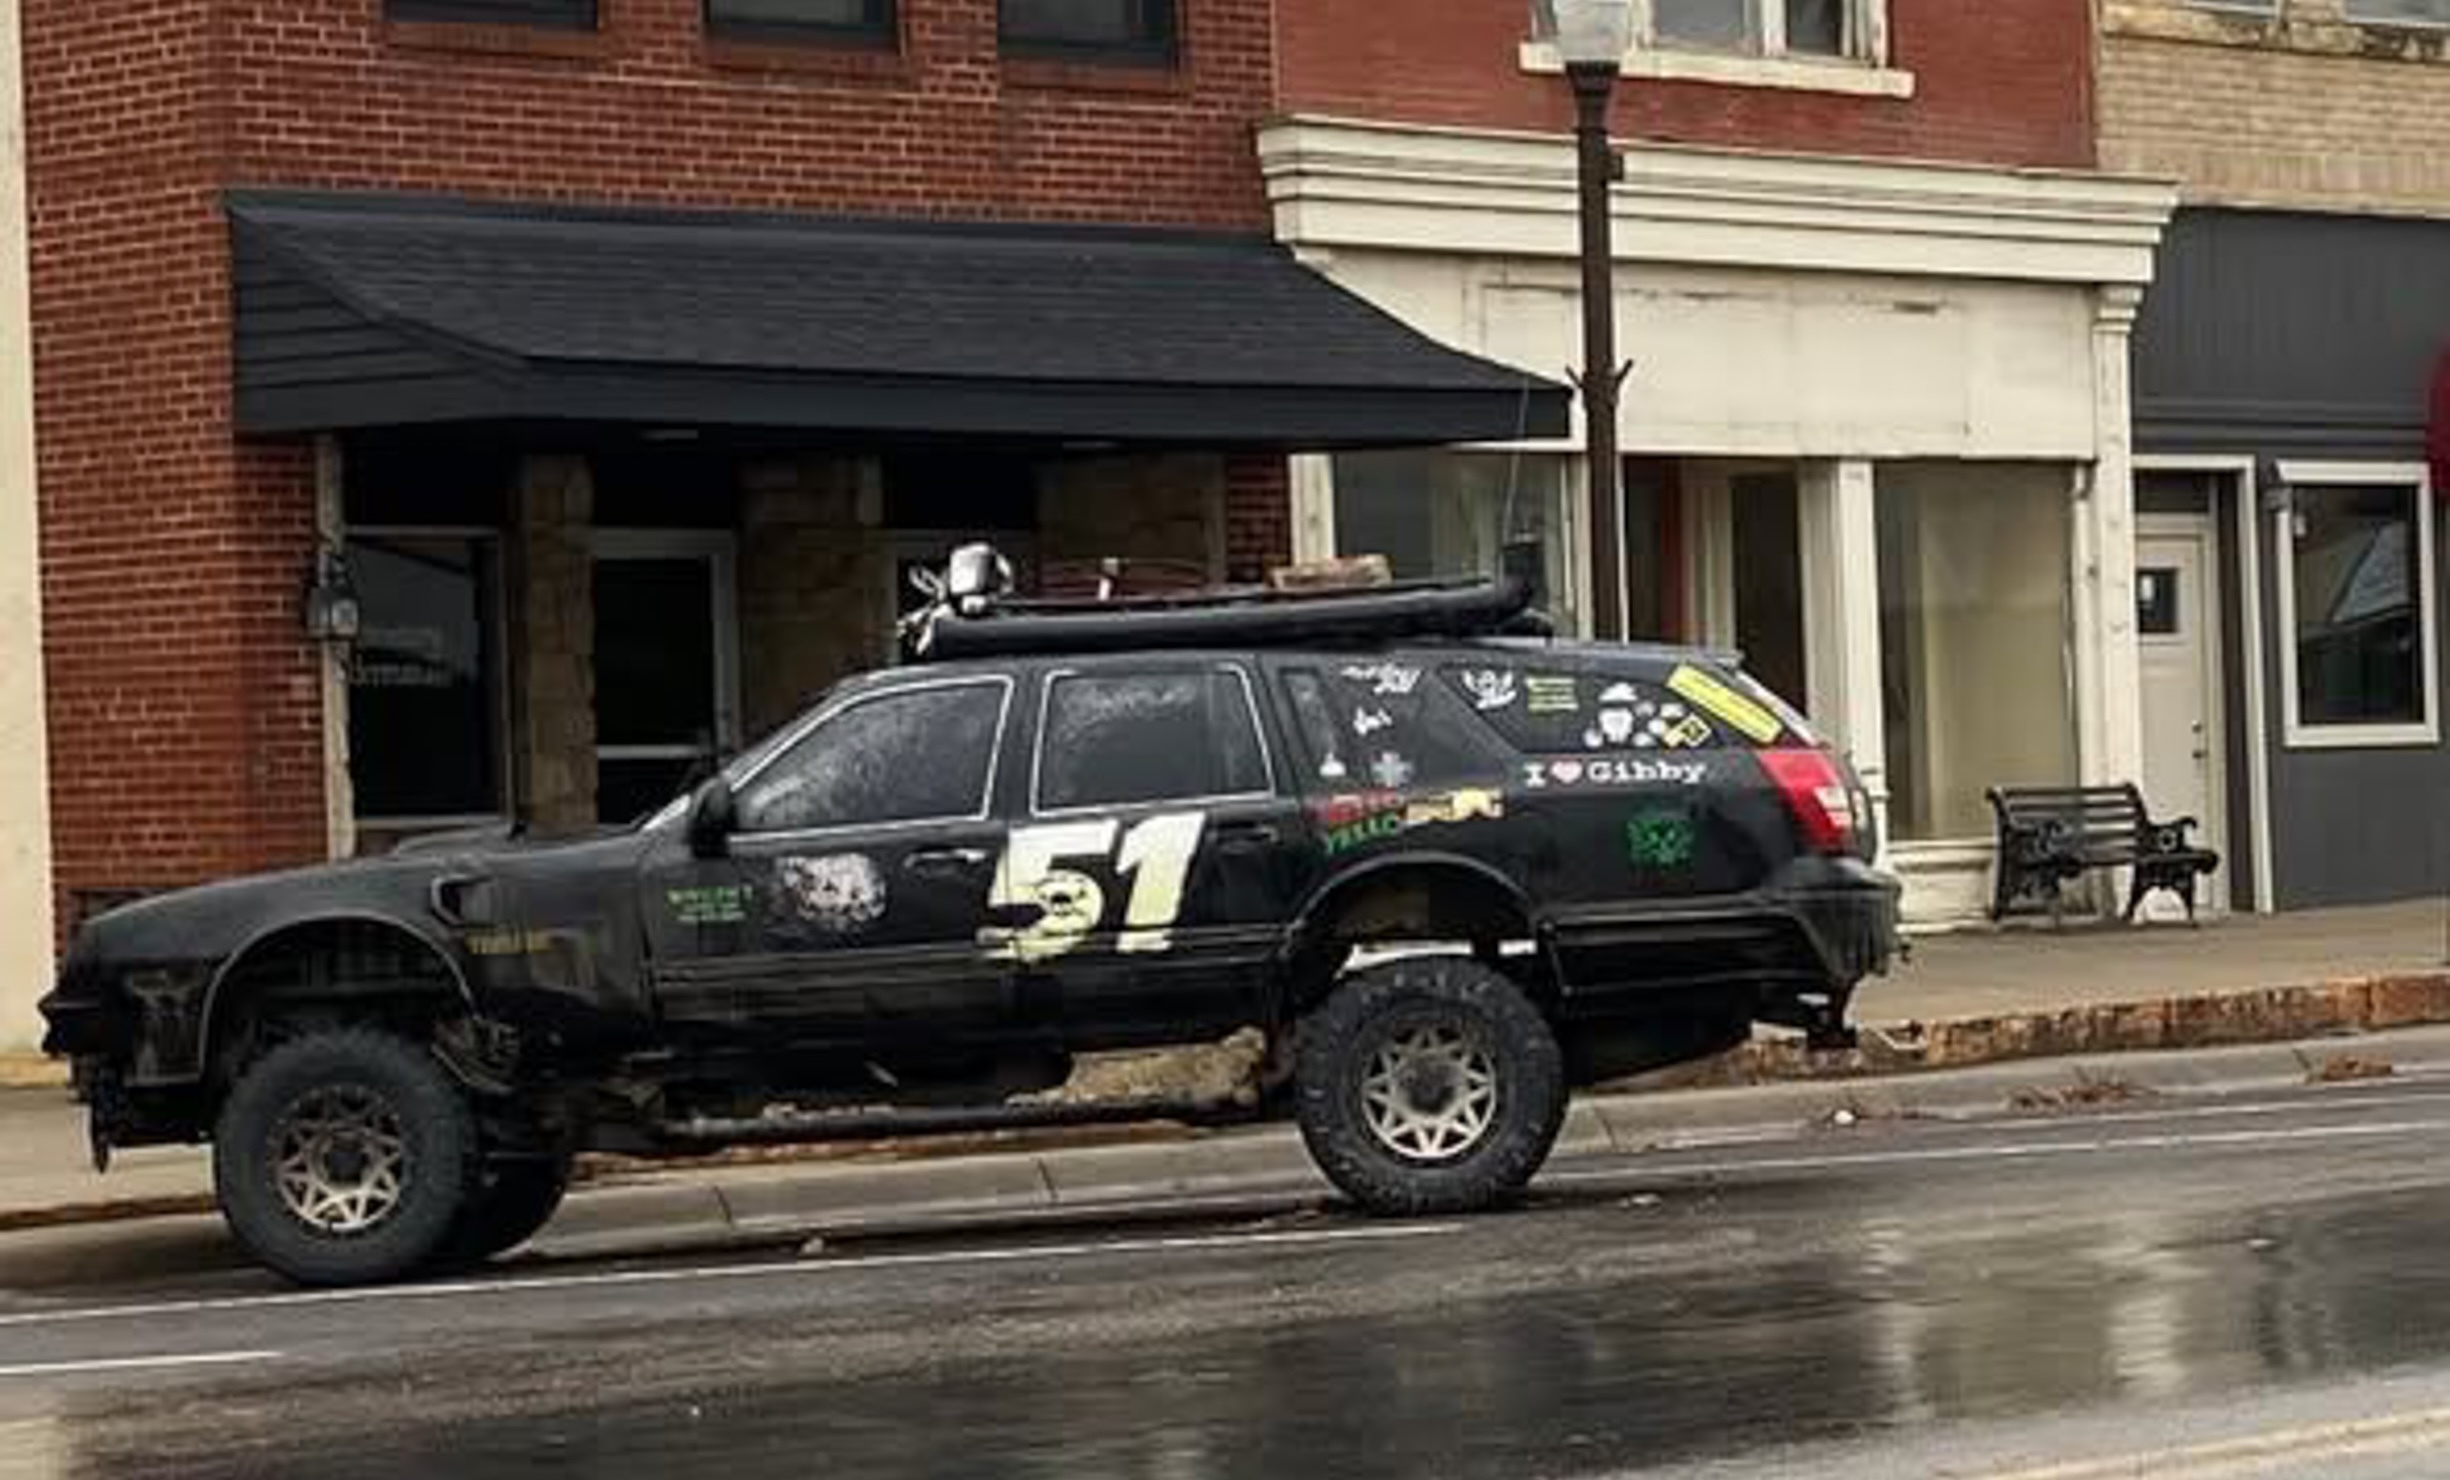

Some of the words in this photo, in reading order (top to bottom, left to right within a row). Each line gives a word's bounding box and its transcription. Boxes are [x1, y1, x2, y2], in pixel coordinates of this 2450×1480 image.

[1523, 763, 1546, 788] I
[1587, 760, 1706, 785] Gibby
[977, 811, 1206, 962] 51
